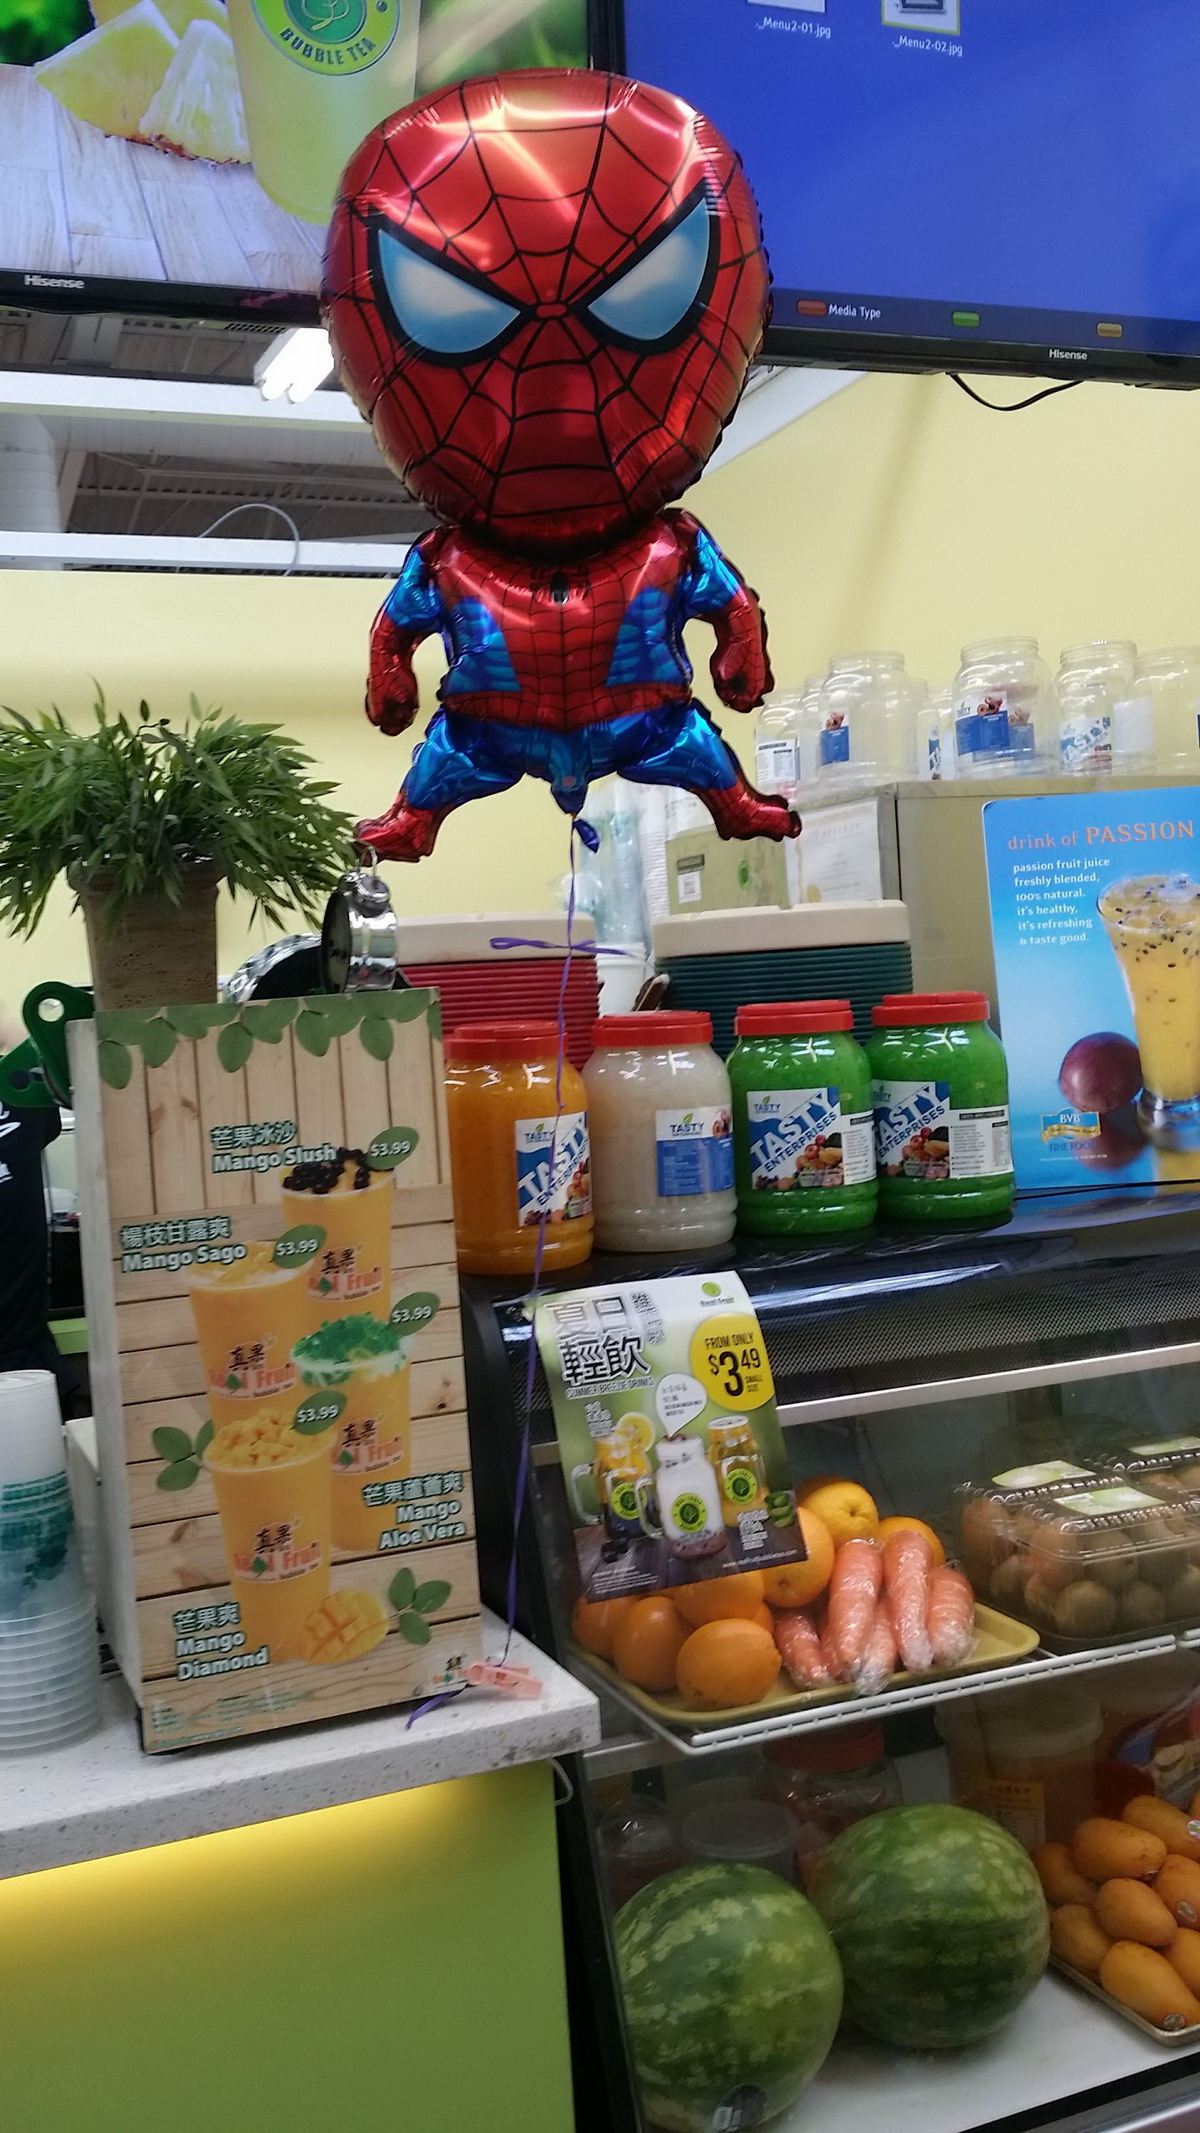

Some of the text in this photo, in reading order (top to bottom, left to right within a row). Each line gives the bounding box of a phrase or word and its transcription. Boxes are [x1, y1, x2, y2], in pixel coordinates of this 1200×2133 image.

[280, 28, 376, 65] BUBBLE TEA
[24, 274, 85, 292] Hisense
[828, 303, 881, 320] Media Type
[1049, 349, 1088, 361] Hisense
[1008, 820, 1194, 850] drink of PASSION
[1013, 858, 1110, 875] passion fruit juice
[1014, 872, 1100, 887] freshly blended,
[1016, 888, 1085, 901] 100% natural.
[1017, 903, 1078, 916] it's healthy,
[1018, 917, 1093, 931] it's refreshing
[1029, 935, 1057, 945] taste
[1060, 932, 1090, 945] good.
[670, 1122, 704, 1133] TASTY
[751, 1088, 839, 1165] TASTY
[1060, 1113, 1080, 1123] BVB
[210, 1120, 297, 1150] 芒果冰沙
[524, 1130, 555, 1140] TASTY
[878, 1105, 945, 1158] ENTERPRISES
[370, 1140, 411, 1158] $3.99
[764, 1111, 837, 1173] ENTERPRISES
[212, 1143, 337, 1174] Mango Slush
[517, 1120, 589, 1200] TASTY
[276, 1237, 319, 1257] $3.99
[121, 1244, 247, 1273] Mango Sago
[391, 1305, 432, 1324] $3.99
[705, 1332, 754, 1350] FROM ONLY
[559, 1332, 651, 1386] 輕飲
[297, 1405, 340, 1424] $3.99
[396, 1500, 461, 1524] Mango
[378, 1521, 467, 1550] Aloe Vera
[173, 1602, 241, 1635] 芒果爽
[176, 1631, 246, 1658] Mango
[177, 1644, 269, 1681] Diamond
